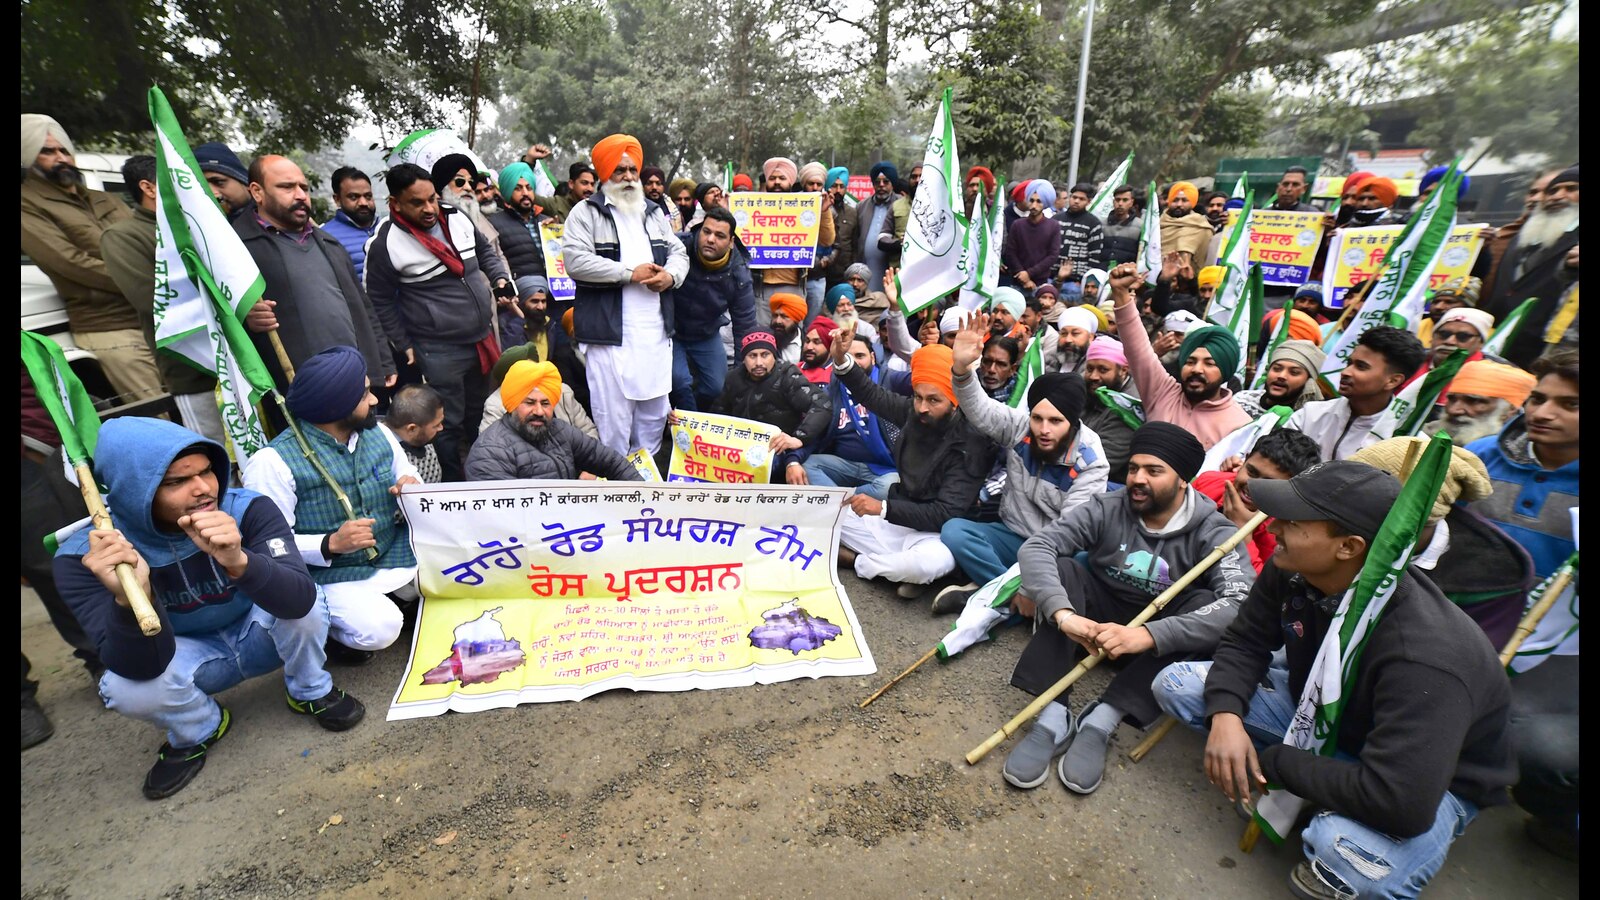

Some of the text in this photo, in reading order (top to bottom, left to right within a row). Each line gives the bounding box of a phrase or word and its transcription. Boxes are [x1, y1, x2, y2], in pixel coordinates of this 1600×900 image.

[752, 210, 797, 227] ਵਿਸ਼ਾਲ
[741, 228, 808, 245] ਰੋਸ ਧਰਨਾ
[1259, 249, 1302, 263] ਧਰਨਾ
[692, 435, 743, 464] ਵਿਸ਼ਾਲ
[684, 454, 755, 483] ਰੋਸ ਧਰਨਾ
[420, 497, 434, 513] ਮੈਂ
[440, 500, 467, 512] ਆਮ
[472, 499, 486, 511] ਨਾ
[492, 498, 515, 509] ਖਾਸ
[521, 497, 534, 508] ਨਾ
[539, 492, 553, 506] ਮੈਂ
[557, 492, 599, 505] ਕਾਂਗਰਸ
[604, 491, 645, 504] ਅਕਾਲੀ,
[652, 491, 665, 502] ਮੈਂ
[669, 492, 682, 502] ਹਾਂ
[686, 492, 711, 503] ਰਾਹੋਂ
[714, 492, 730, 504] ਰੋਡ
[756, 493, 788, 504] ਵਿਕਾਸ
[792, 494, 804, 504] ਤੋਂ
[807, 494, 830, 505] ਖਾਲੀ
[441, 508, 823, 586] ਰਾਹੋਂ ਰੋਡ ਸੰਘਰਸ਼ ਟੀਮ
[527, 563, 743, 602] ਰੋਸ ਪ੍ਰਦਰਸ਼ਨ
[595, 606, 626, 614] 25-30
[586, 659, 619, 675] ਸਰਕਾਰ
